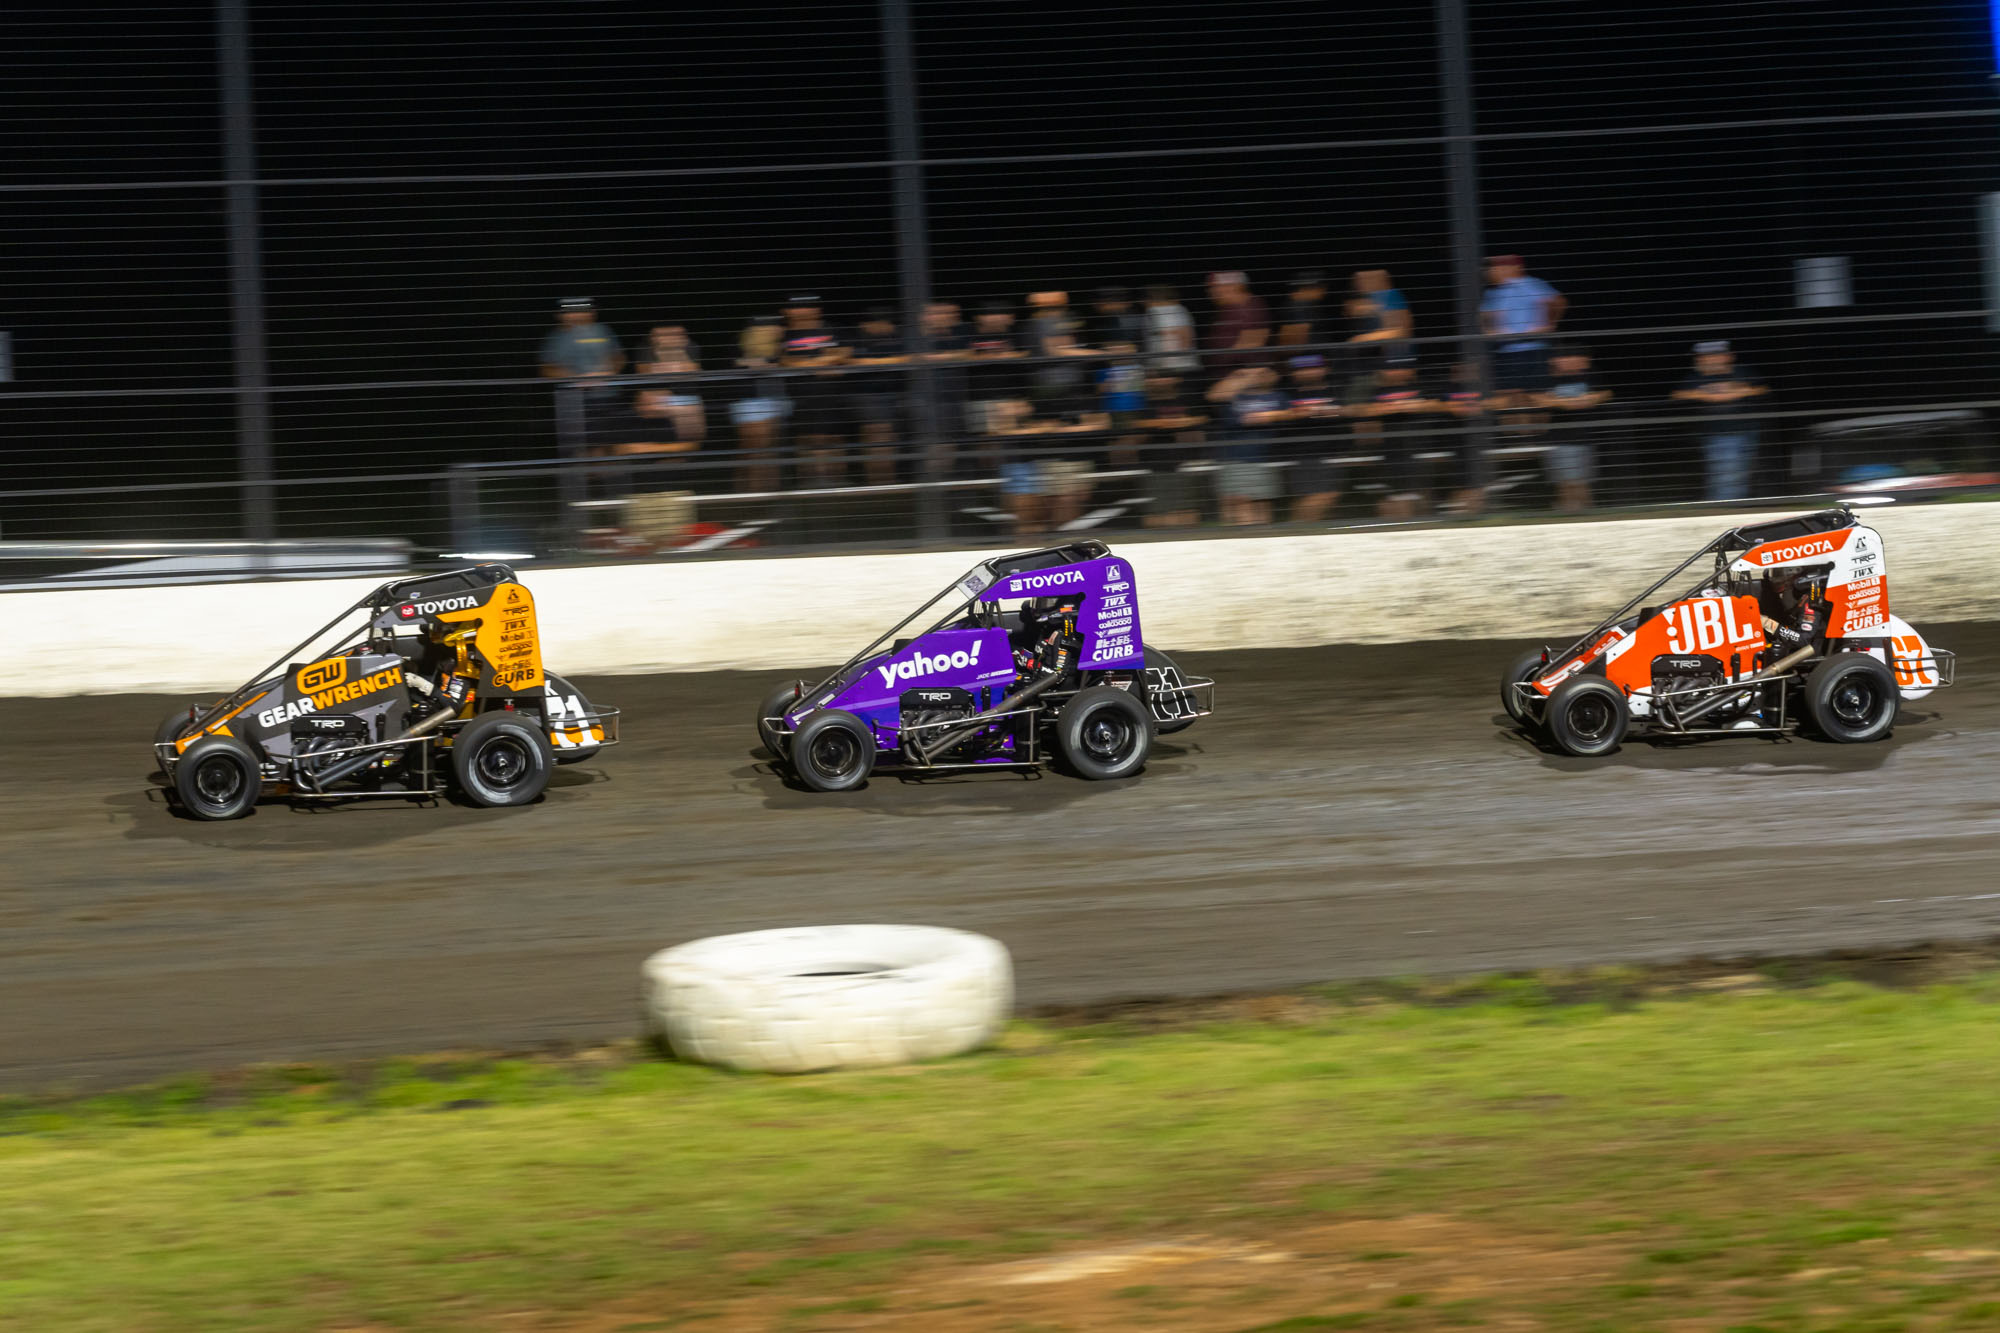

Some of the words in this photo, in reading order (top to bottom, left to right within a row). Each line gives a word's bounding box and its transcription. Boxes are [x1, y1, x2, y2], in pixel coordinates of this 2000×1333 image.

[1773, 539, 1834, 561] TOYOTA
[1851, 553, 1876, 564] TRD
[1023, 570, 1085, 589] TOYOTA
[1853, 566, 1874, 578] IWX
[1102, 581, 1130, 593] TRD
[1847, 579, 1871, 592] Mobil
[414, 595, 479, 615] TOYOTA
[1104, 595, 1127, 608] IWX
[1098, 609, 1122, 621] Mobil
[1843, 613, 1883, 633] CURB
[1668, 596, 1754, 654] JBL
[1092, 645, 1134, 661] CURB
[1891, 635, 1932, 686] 67
[877, 640, 982, 689] yahoo!
[1669, 660, 1701, 669] TRD
[494, 668, 535, 685] CURB
[258, 667, 403, 728] GEARWRENCH
[918, 692, 951, 702] TRD
[1145, 667, 1197, 721] 71
[310, 720, 345, 729] TRD
[545, 694, 600, 749] 71
